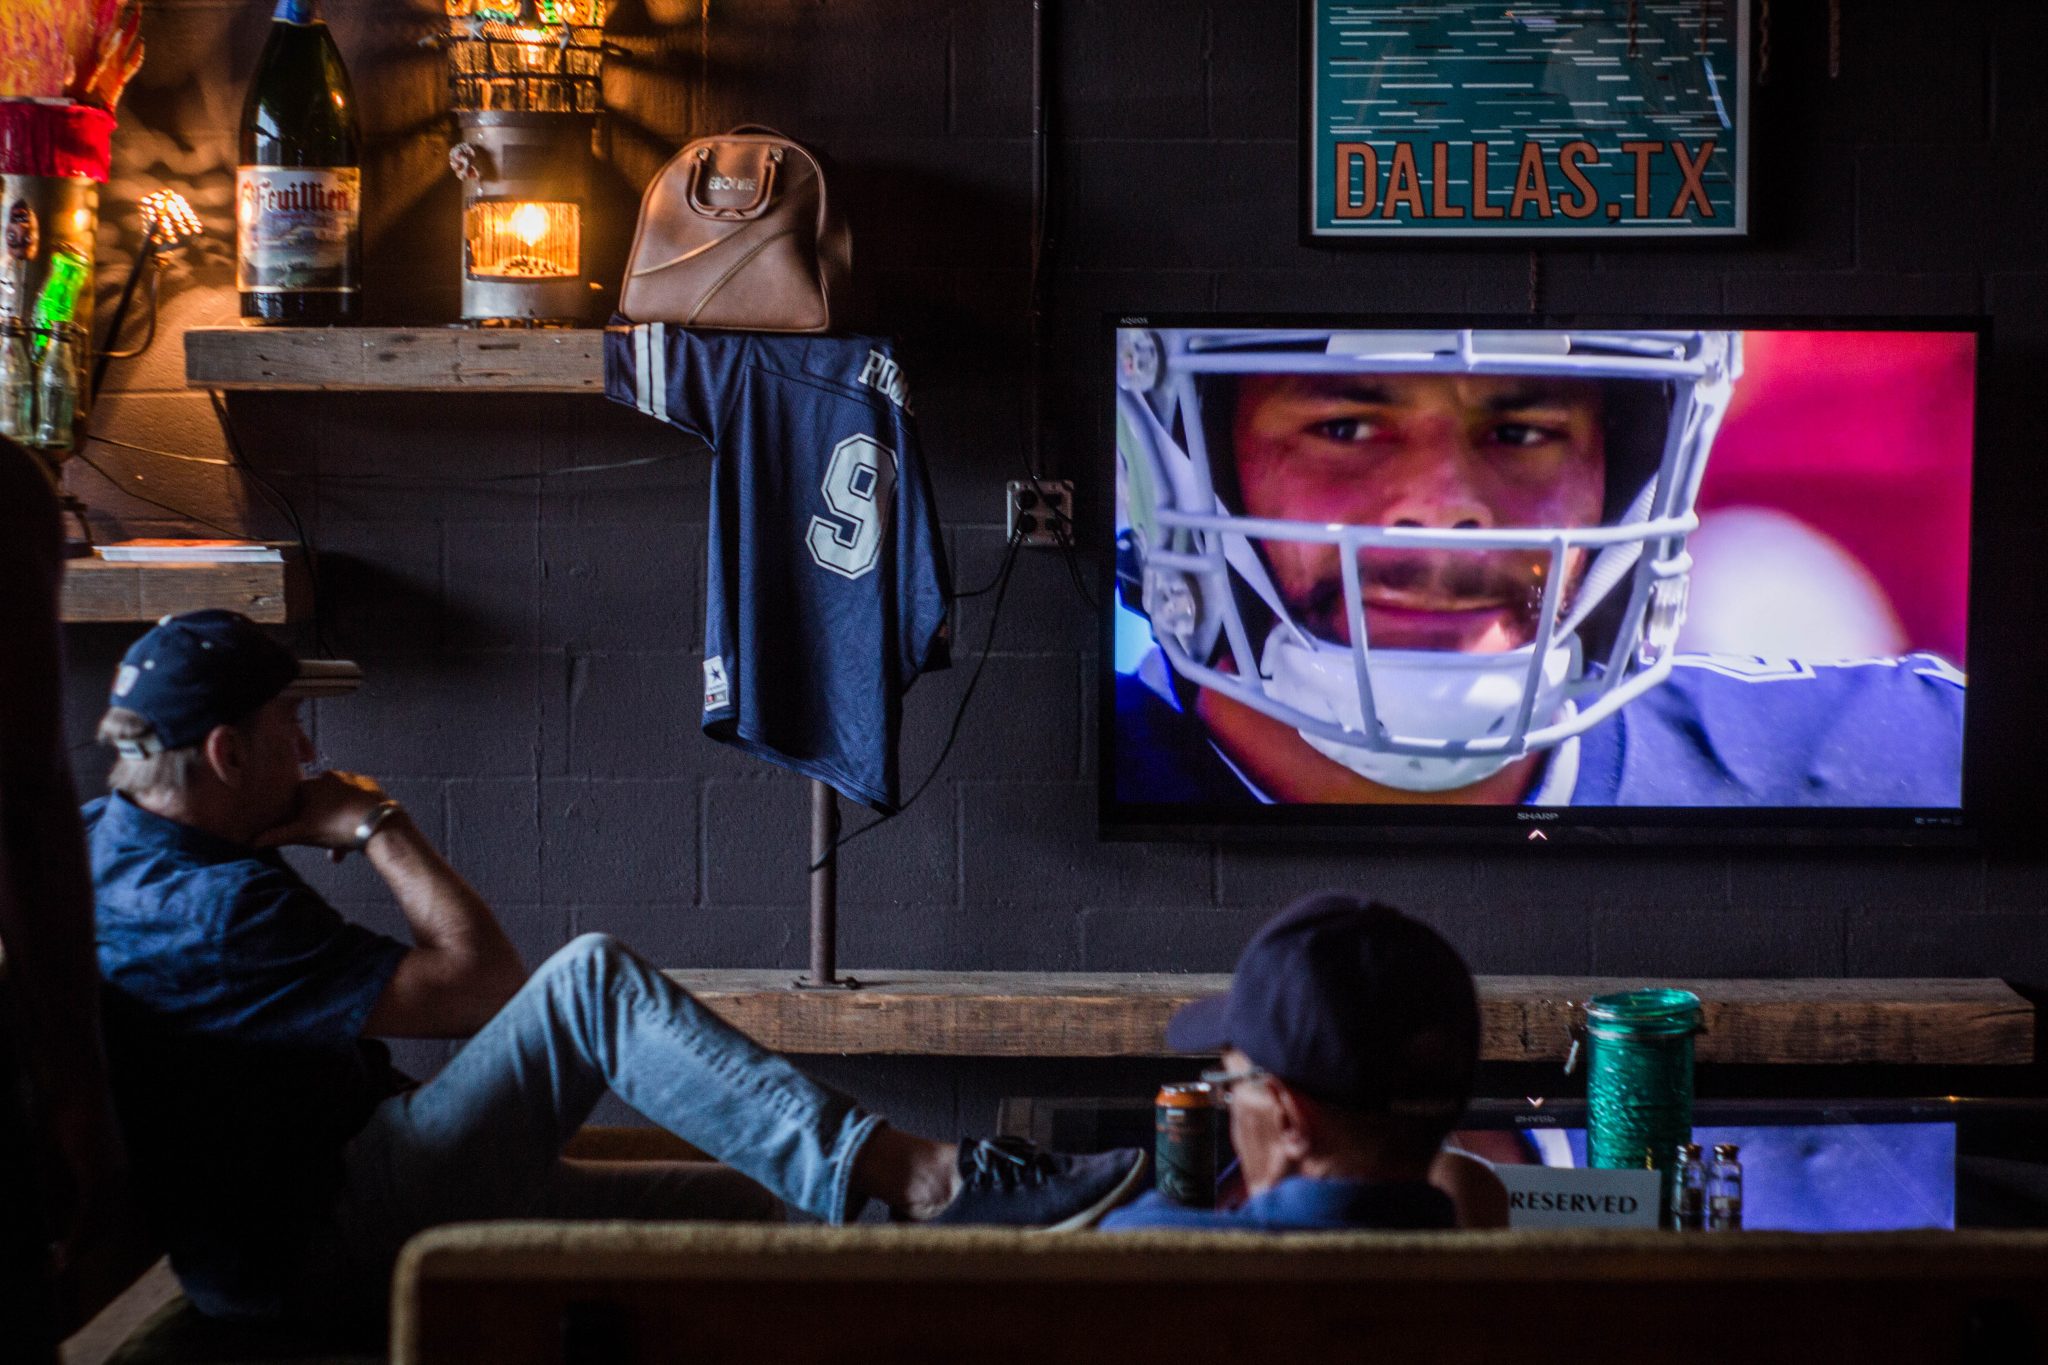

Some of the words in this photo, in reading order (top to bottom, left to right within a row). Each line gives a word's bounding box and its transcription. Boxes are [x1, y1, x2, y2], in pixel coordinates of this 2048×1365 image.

[805, 432, 899, 581] 9
[1517, 811, 1560, 821] SHARP
[1510, 1191, 1638, 1215] RESERVED
